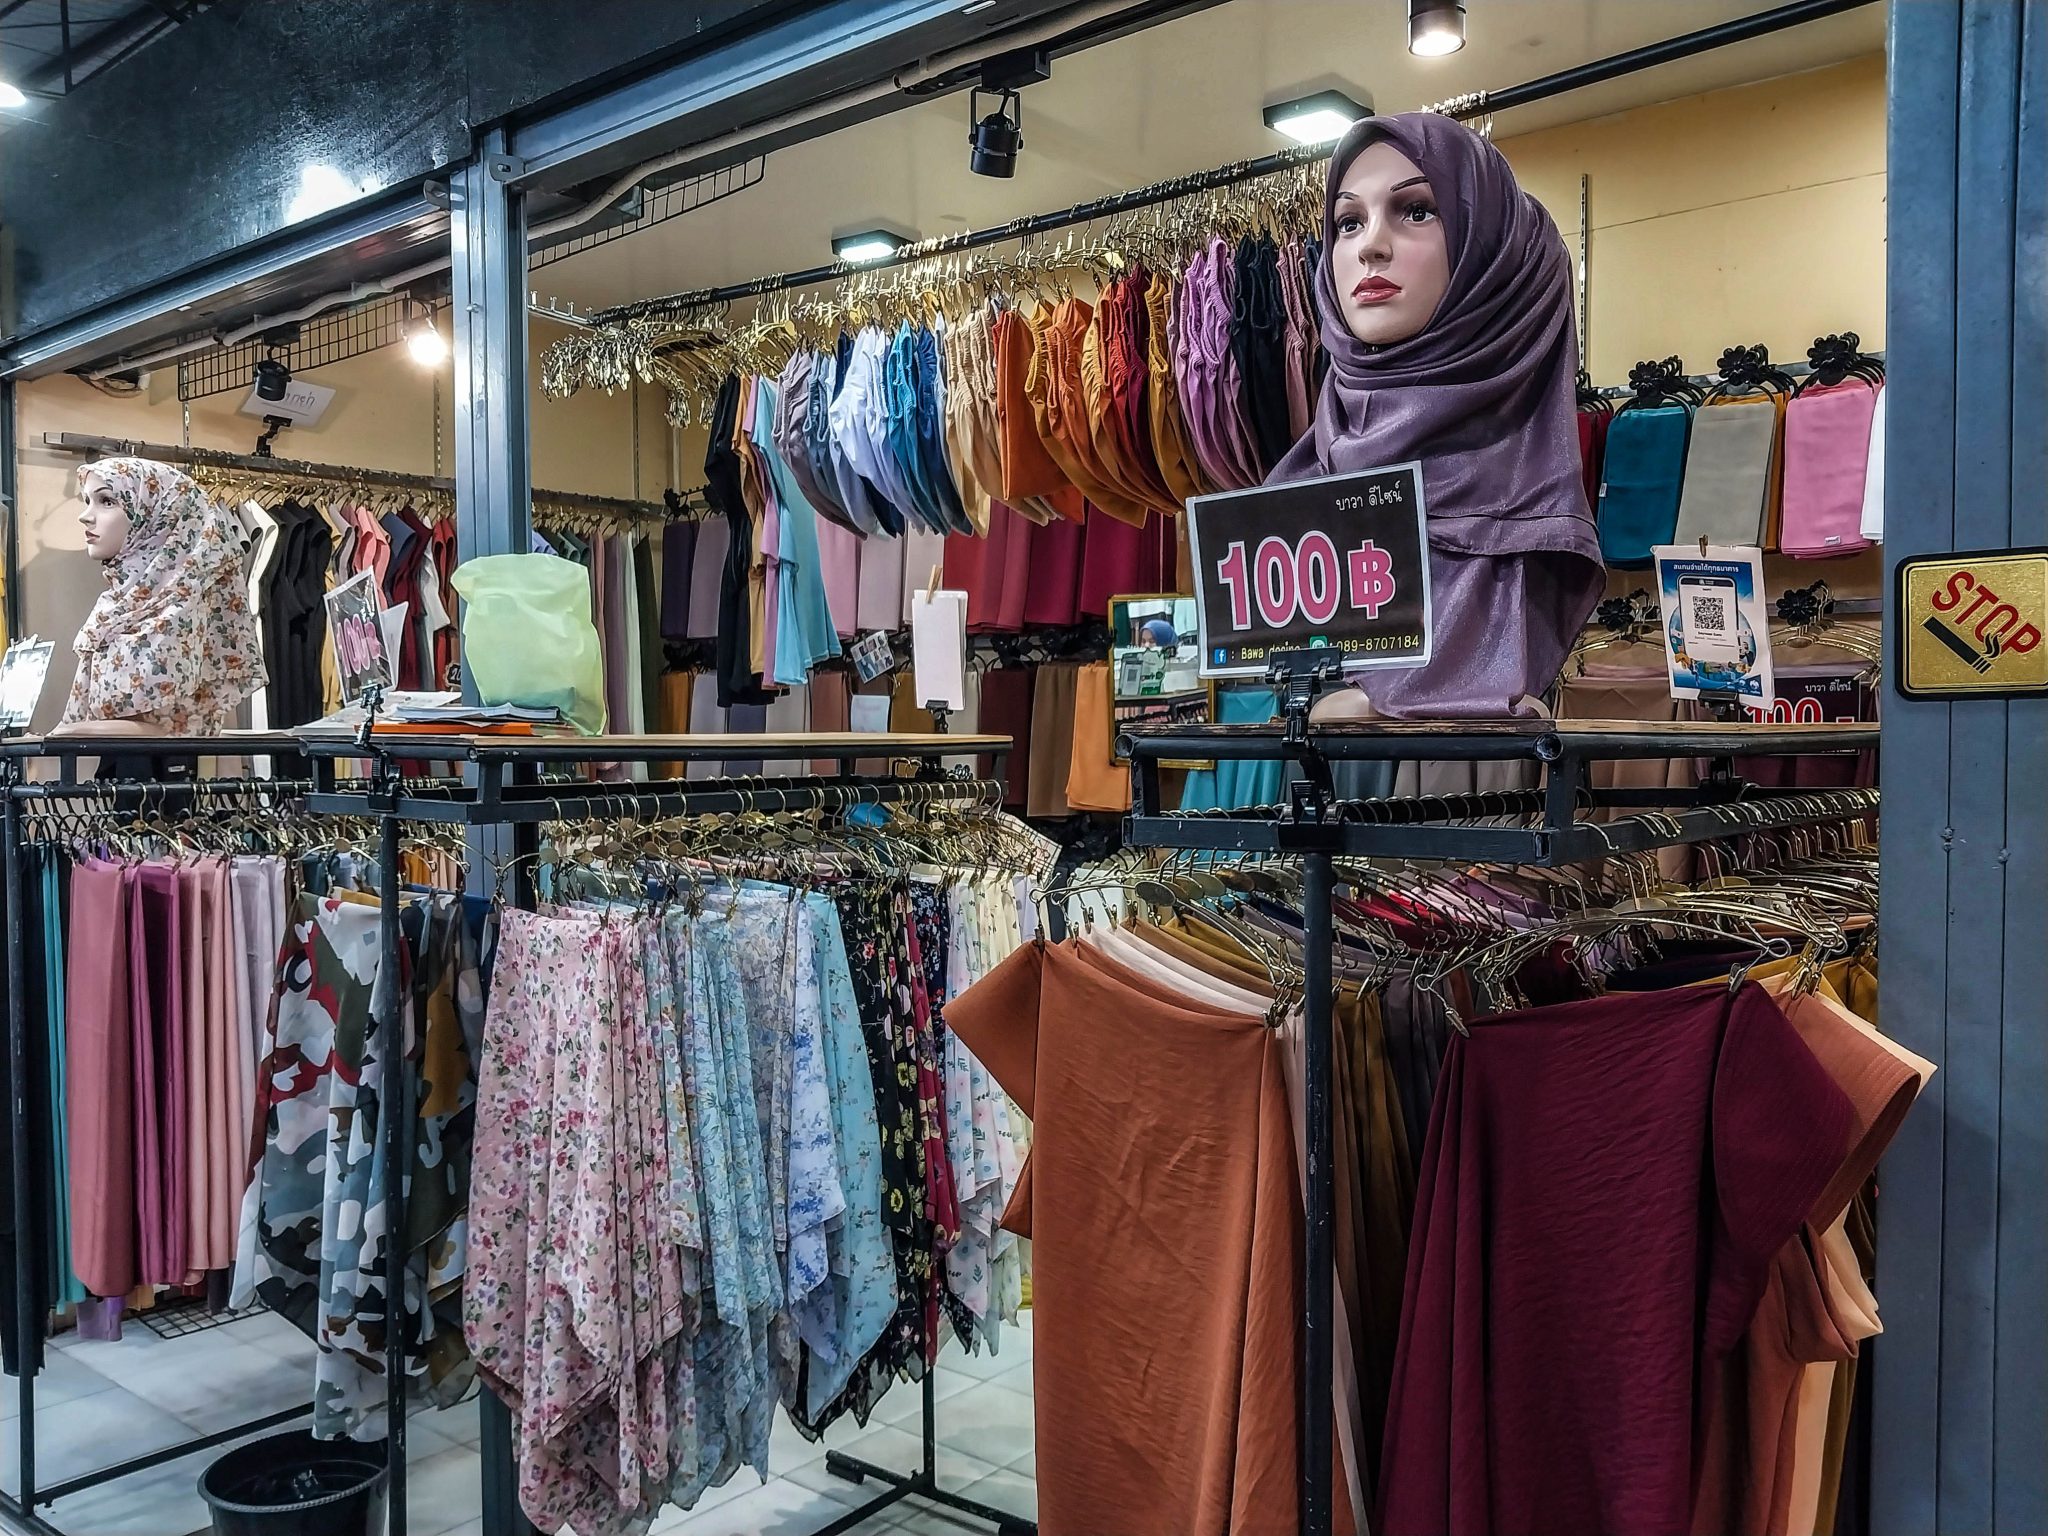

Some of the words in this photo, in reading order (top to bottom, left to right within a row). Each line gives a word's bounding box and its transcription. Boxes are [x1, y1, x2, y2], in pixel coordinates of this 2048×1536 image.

[1335, 496, 1364, 511] บาวา
[1368, 480, 1403, 506] ดีไซน์
[1930, 570, 2042, 655] STOP
[1240, 647, 1264, 660] Bawa
[1337, 635, 1420, 652] 089-8707184
